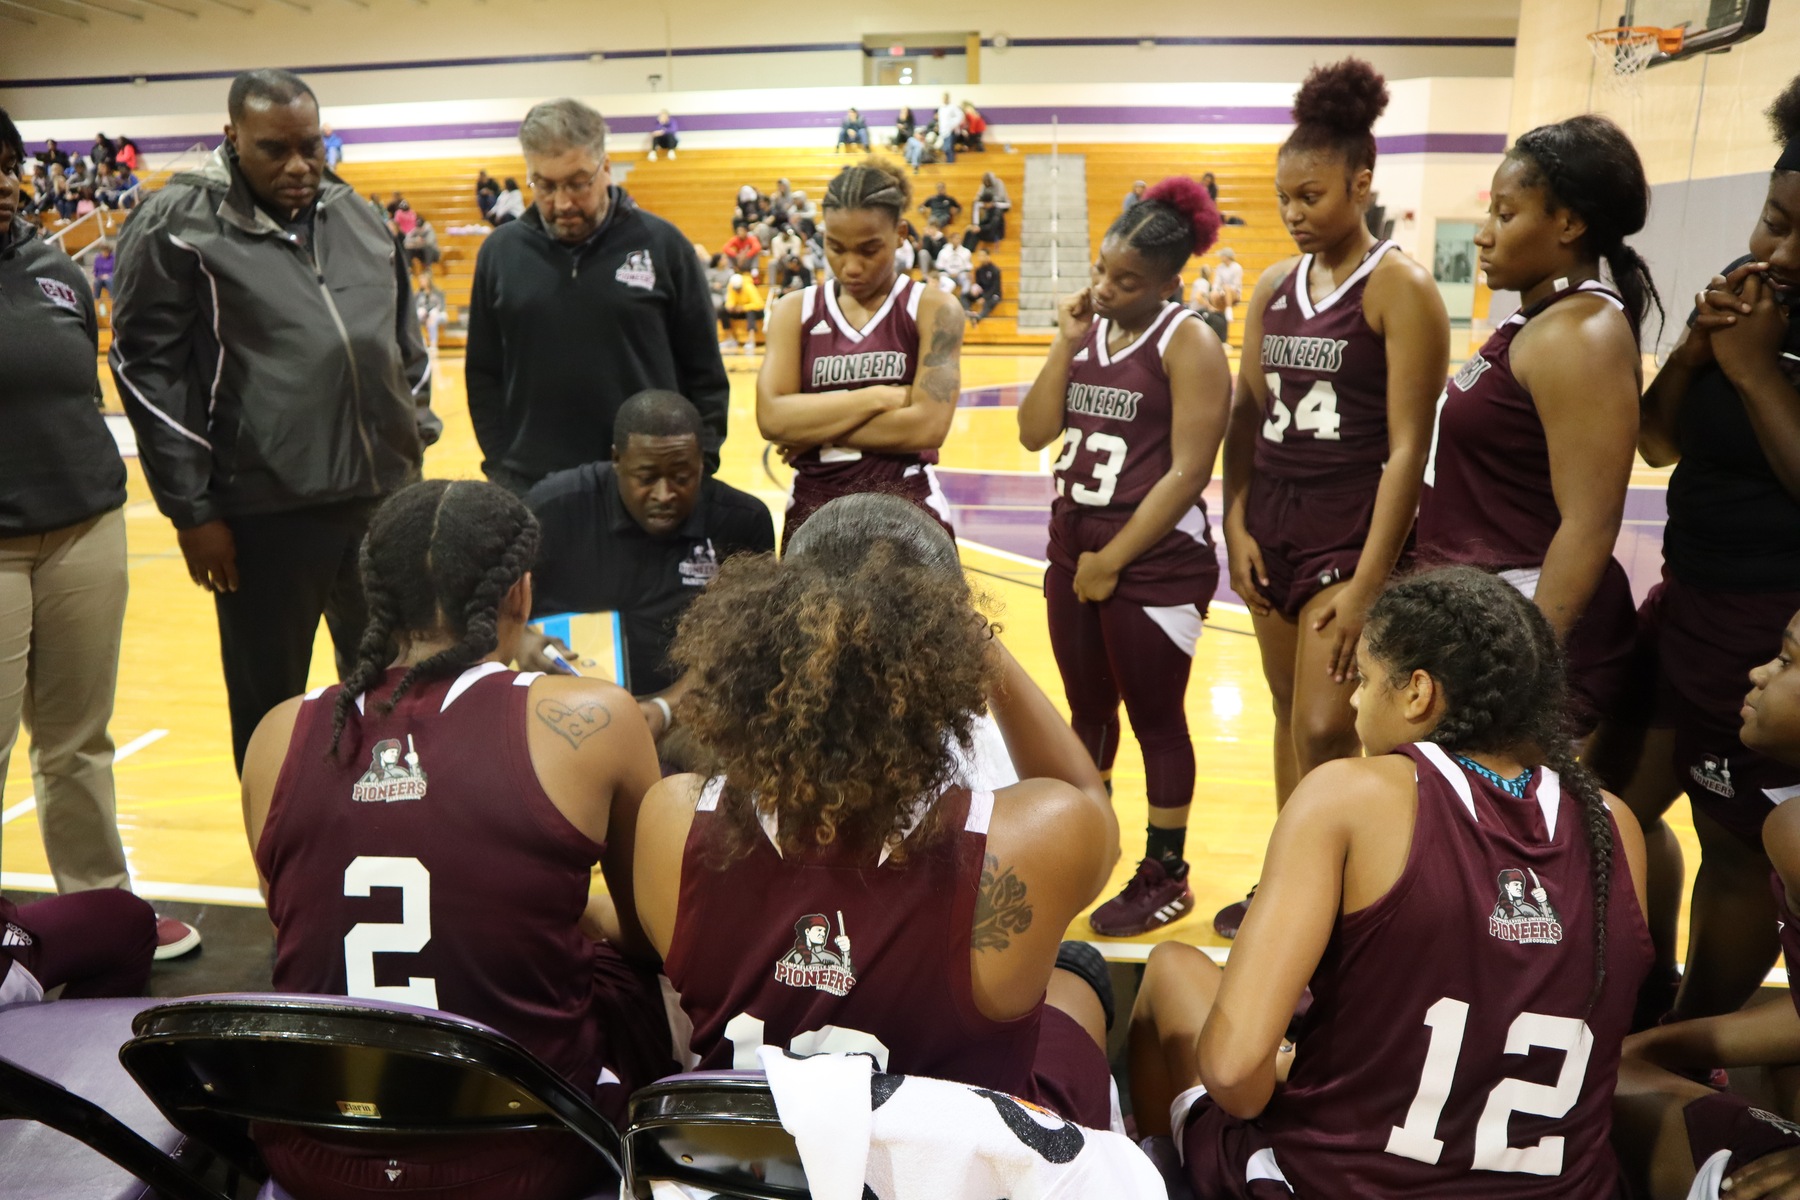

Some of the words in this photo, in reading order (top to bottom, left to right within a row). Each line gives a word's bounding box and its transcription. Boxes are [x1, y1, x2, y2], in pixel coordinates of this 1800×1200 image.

[811, 351, 907, 387] PIONEERS
[1261, 335, 1349, 373] PIONEERS
[1052, 427, 1128, 507] 23
[352, 780, 427, 802] PIONEERS
[343, 856, 440, 1011] 2
[1490, 917, 1562, 941] PIONEERS
[775, 961, 856, 994] PIONEERS
[1384, 997, 1594, 1176] 12
